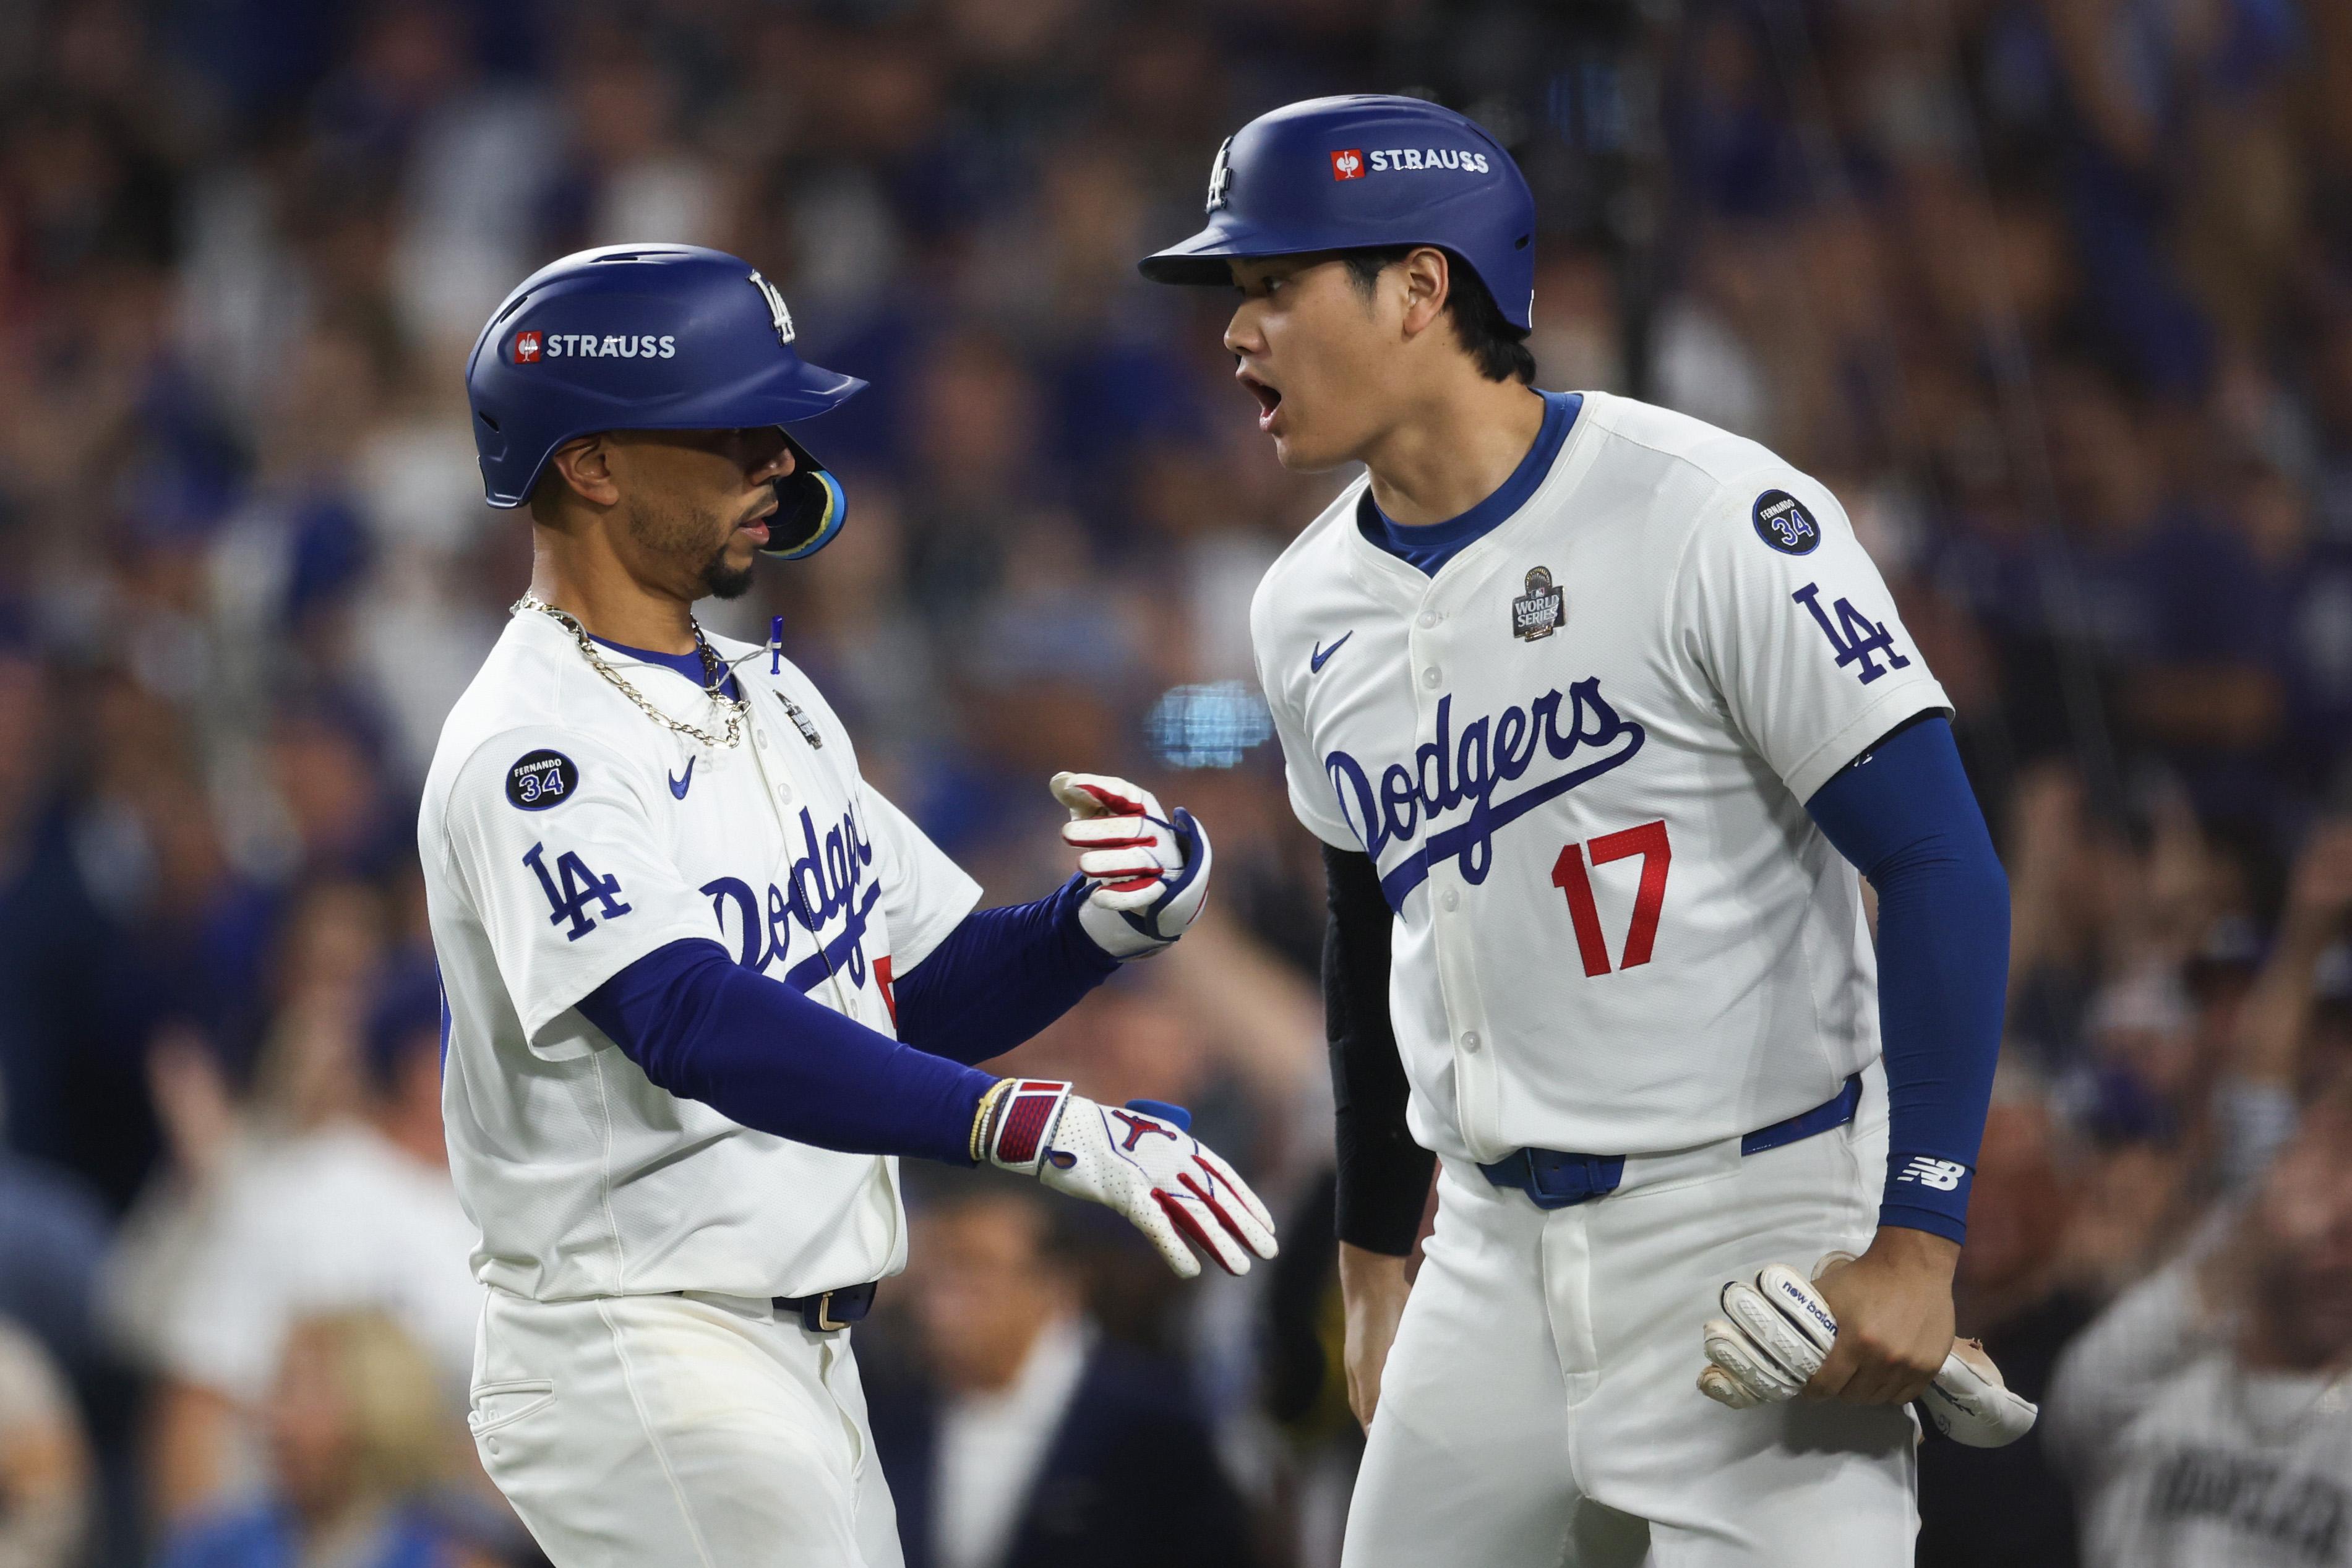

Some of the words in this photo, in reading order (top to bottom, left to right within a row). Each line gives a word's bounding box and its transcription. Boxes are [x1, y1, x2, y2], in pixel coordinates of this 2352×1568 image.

[1370, 148, 1489, 174] STRAUSS
[546, 335, 676, 359] STRAUSS
[1760, 499, 1795, 520] FERNANDO
[1772, 509, 1814, 546] 34
[1515, 594, 1559, 615] WORLD
[1517, 606, 1558, 627] SERIES
[1792, 582, 1910, 685] LA
[514, 758, 562, 778] FERNANDO
[519, 768, 564, 802] 34
[1326, 676, 1646, 925] Dodgers
[522, 842, 632, 941] LA
[1552, 820, 1672, 977] 17
